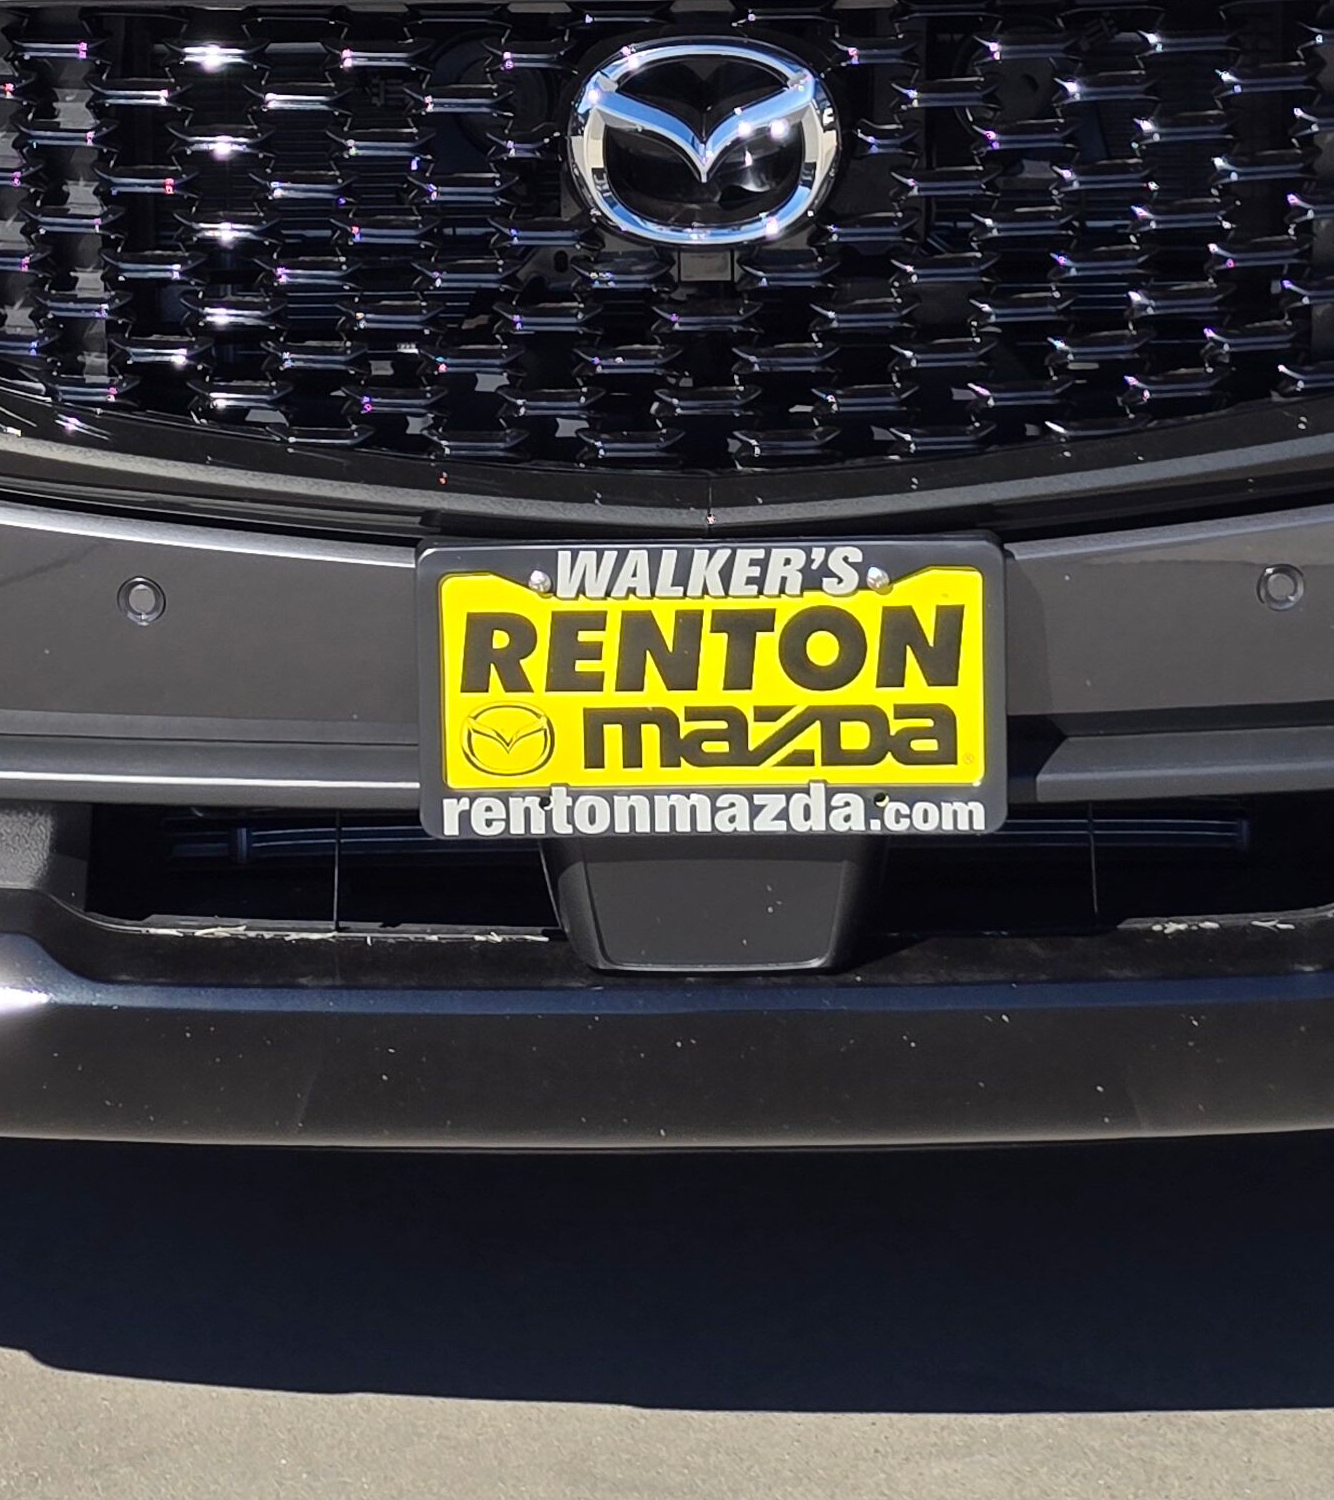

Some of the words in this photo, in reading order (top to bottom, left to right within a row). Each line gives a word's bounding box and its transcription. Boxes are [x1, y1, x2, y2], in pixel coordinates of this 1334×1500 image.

[555, 546, 864, 599] WALKER'S
[460, 604, 965, 694] RENTON
[583, 702, 960, 769] mazda
[441, 781, 987, 836] rentonmazda.com
